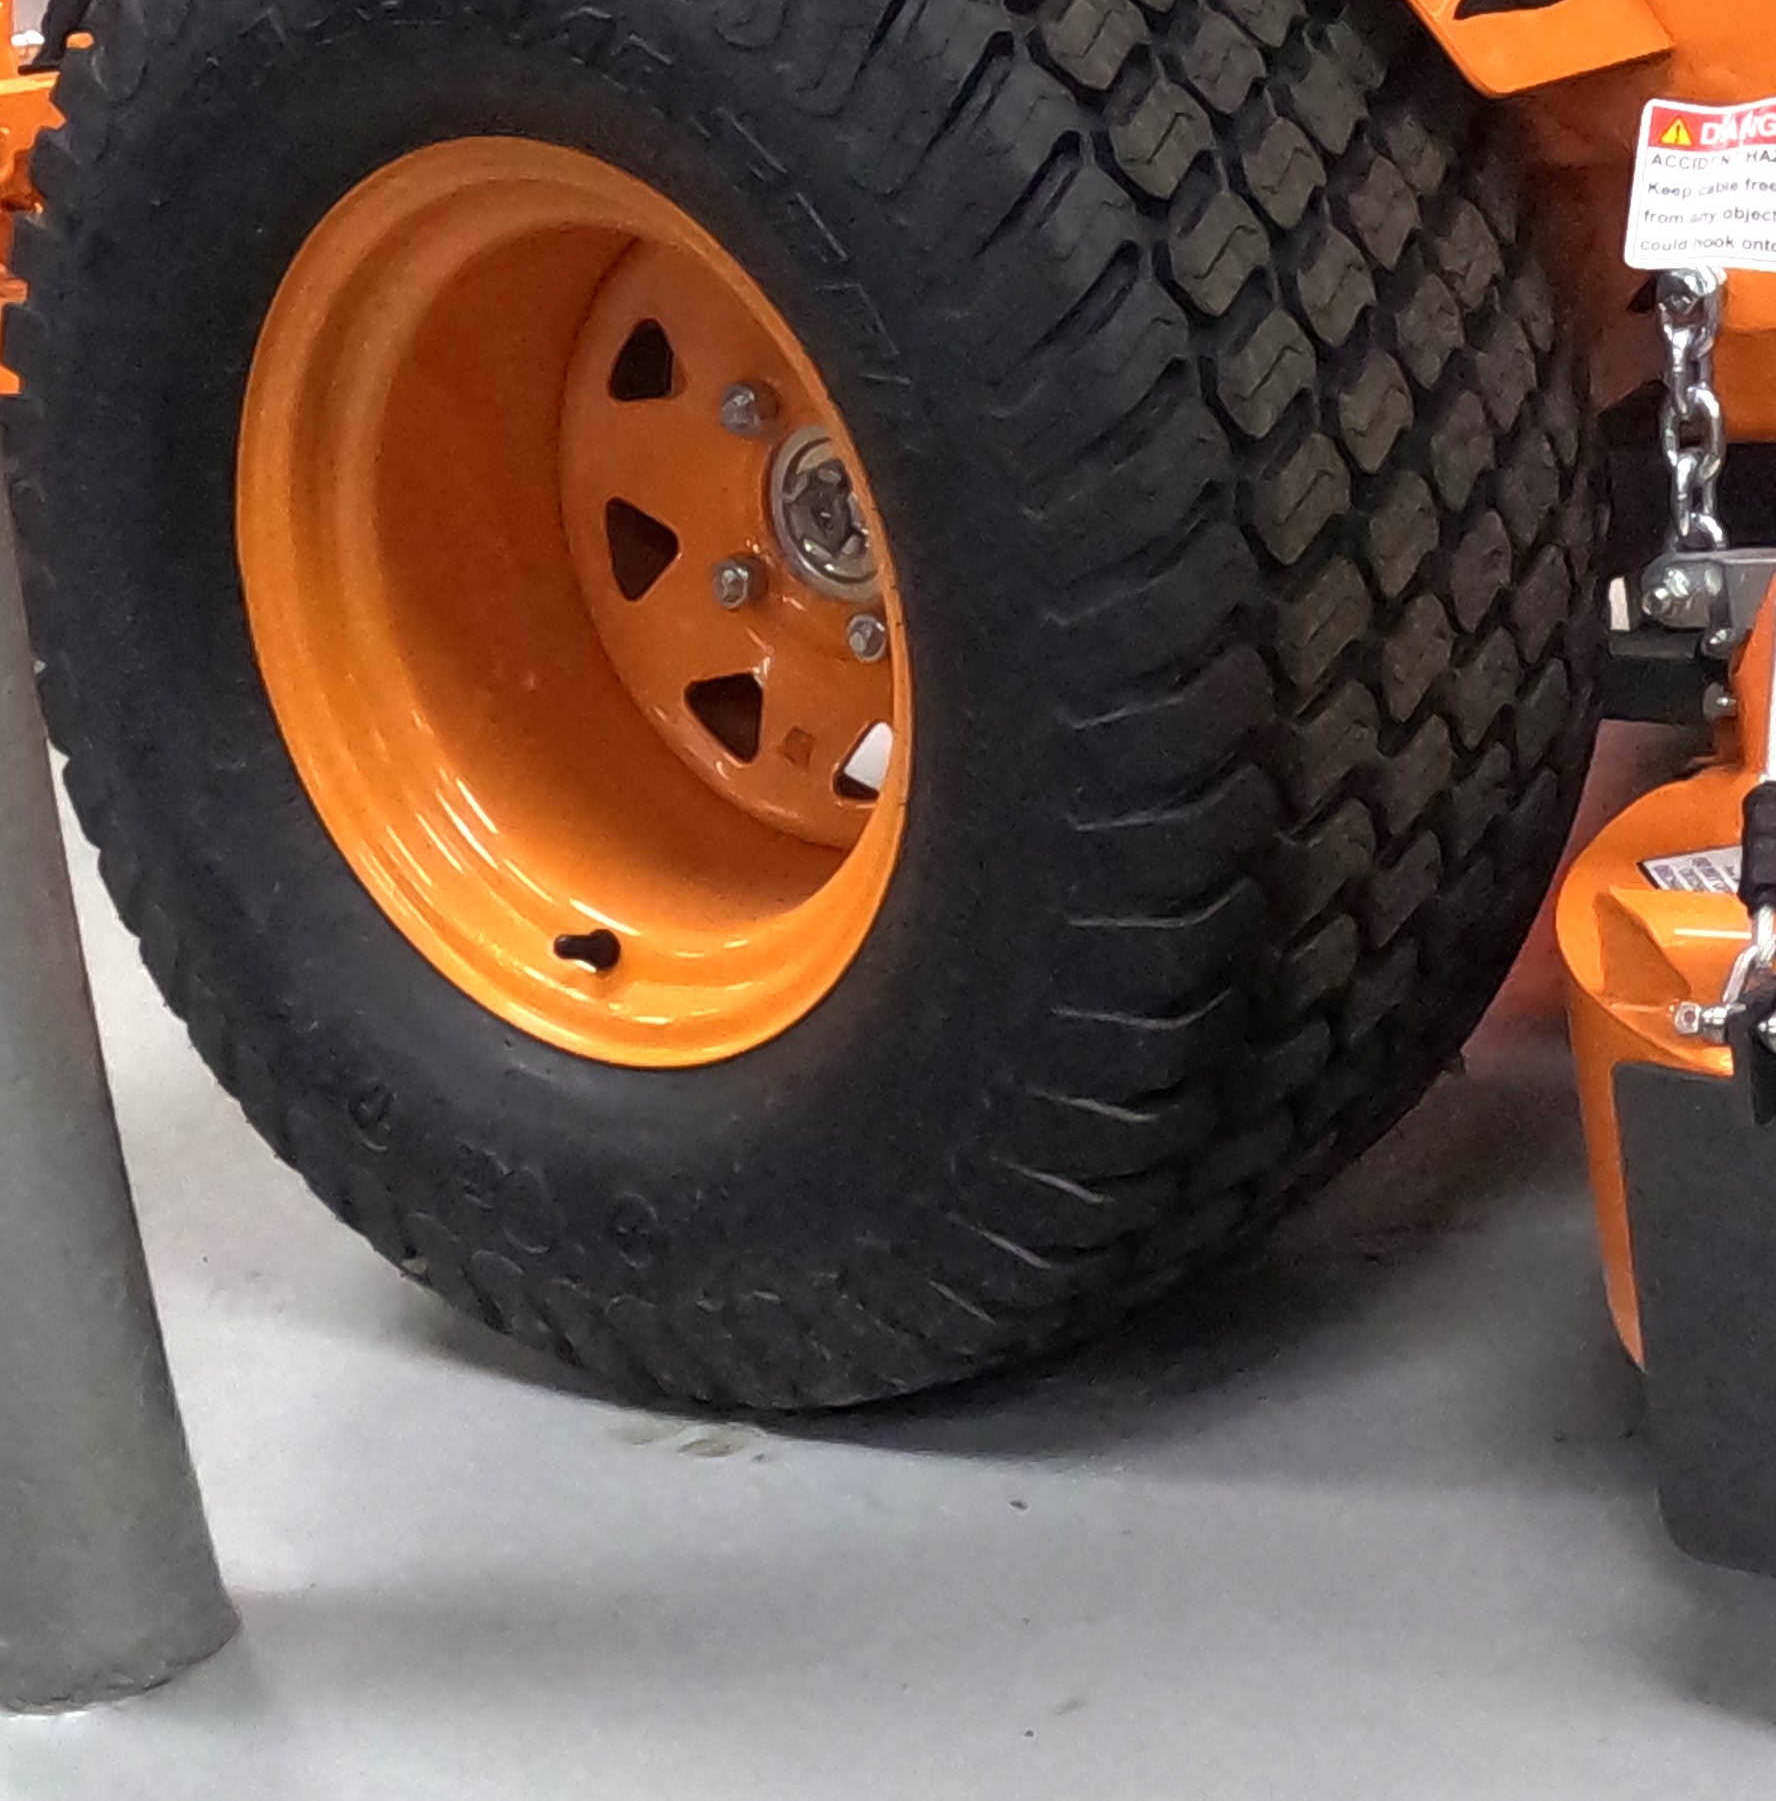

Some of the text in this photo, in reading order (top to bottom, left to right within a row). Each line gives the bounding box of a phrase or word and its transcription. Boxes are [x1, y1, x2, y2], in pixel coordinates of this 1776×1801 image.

[1650, 154, 1740, 170] ACCIDN
[1648, 182, 1692, 199] Keep
[1644, 210, 1684, 224] from
[1723, 207, 1776, 224] object
[1640, 239, 1688, 252] could
